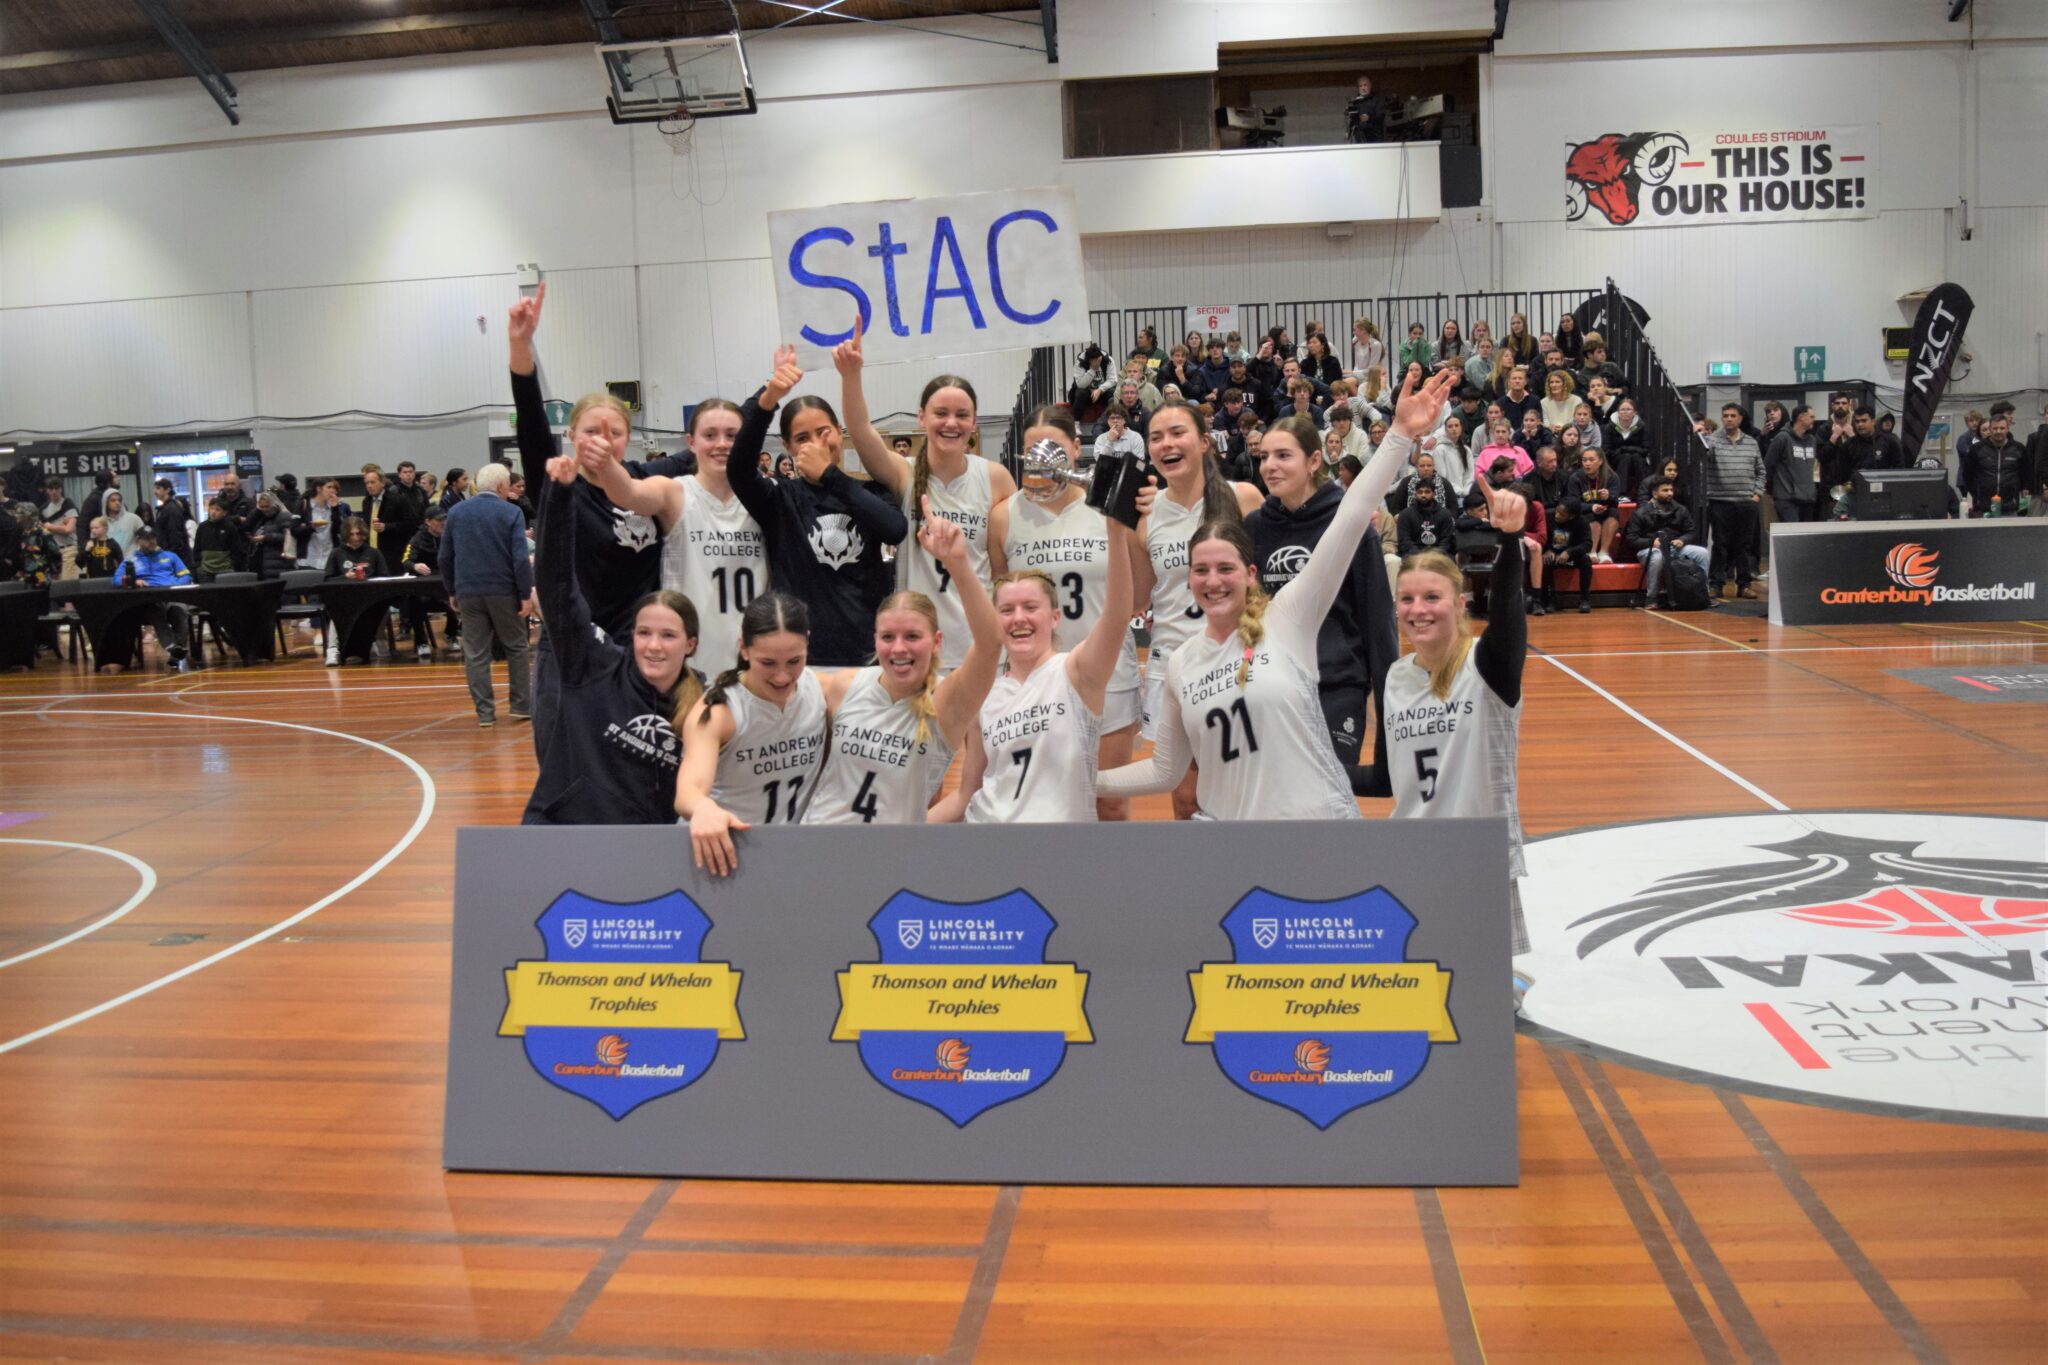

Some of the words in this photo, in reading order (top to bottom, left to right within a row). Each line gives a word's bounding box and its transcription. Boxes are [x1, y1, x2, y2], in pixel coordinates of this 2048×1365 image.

[1716, 132, 1767, 144] COWLES
[1771, 130, 1826, 142] STADIUM
[1711, 145, 1790, 178] THIS
[1801, 144, 1832, 176] IS
[1652, 183, 1728, 216] OUR
[1739, 177, 1865, 212] HOUSE!
[788, 209, 1061, 347] StAC
[1196, 306, 1229, 314] SECTION
[1208, 316, 1218, 329] 6
[1912, 299, 1956, 393] NZCT
[78, 454, 130, 473] SHED
[689, 530, 704, 542] ST
[703, 545, 761, 558] COLLEGE
[1015, 543, 1029, 557] ST
[1032, 537, 1107, 551] ANDREW'S
[1027, 551, 1093, 566] COLLEGE
[712, 567, 755, 614] 10
[1061, 572, 1084, 620] 3
[996, 702, 1065, 730] ANDREW'S
[1386, 713, 1395, 730] ST
[835, 724, 848, 737] ST
[991, 718, 1049, 747] COLLEGE
[1205, 696, 1259, 763] 21
[1395, 719, 1456, 742] COLLEGE
[736, 748, 754, 762] ST
[753, 751, 815, 775] COLLEGE
[841, 742, 909, 767] COLLEGE
[1011, 748, 1032, 800] 7
[1414, 748, 1438, 803] 5
[852, 771, 877, 823] 4
[592, 919, 655, 929] LINCOLN
[929, 919, 995, 929] LINCOLN
[1285, 918, 1353, 928] LINCOLN
[592, 930, 682, 940] UNIVERSITY
[929, 931, 1024, 941] UNIVERSITY
[1285, 929, 1384, 939] UNIVERSITY
[537, 972, 608, 987] Thomson
[613, 972, 645, 987] and
[650, 973, 713, 988] Whelan
[871, 974, 947, 989] Thomson
[952, 974, 987, 989] and
[990, 974, 1058, 990] Whelan
[1226, 974, 1304, 989] Thomson
[1310, 974, 1345, 989] and
[1351, 973, 1420, 989] Whelan
[589, 997, 658, 1014] Trophies
[927, 1000, 1001, 1018] Trophies
[1284, 1000, 1361, 1018] Trophies
